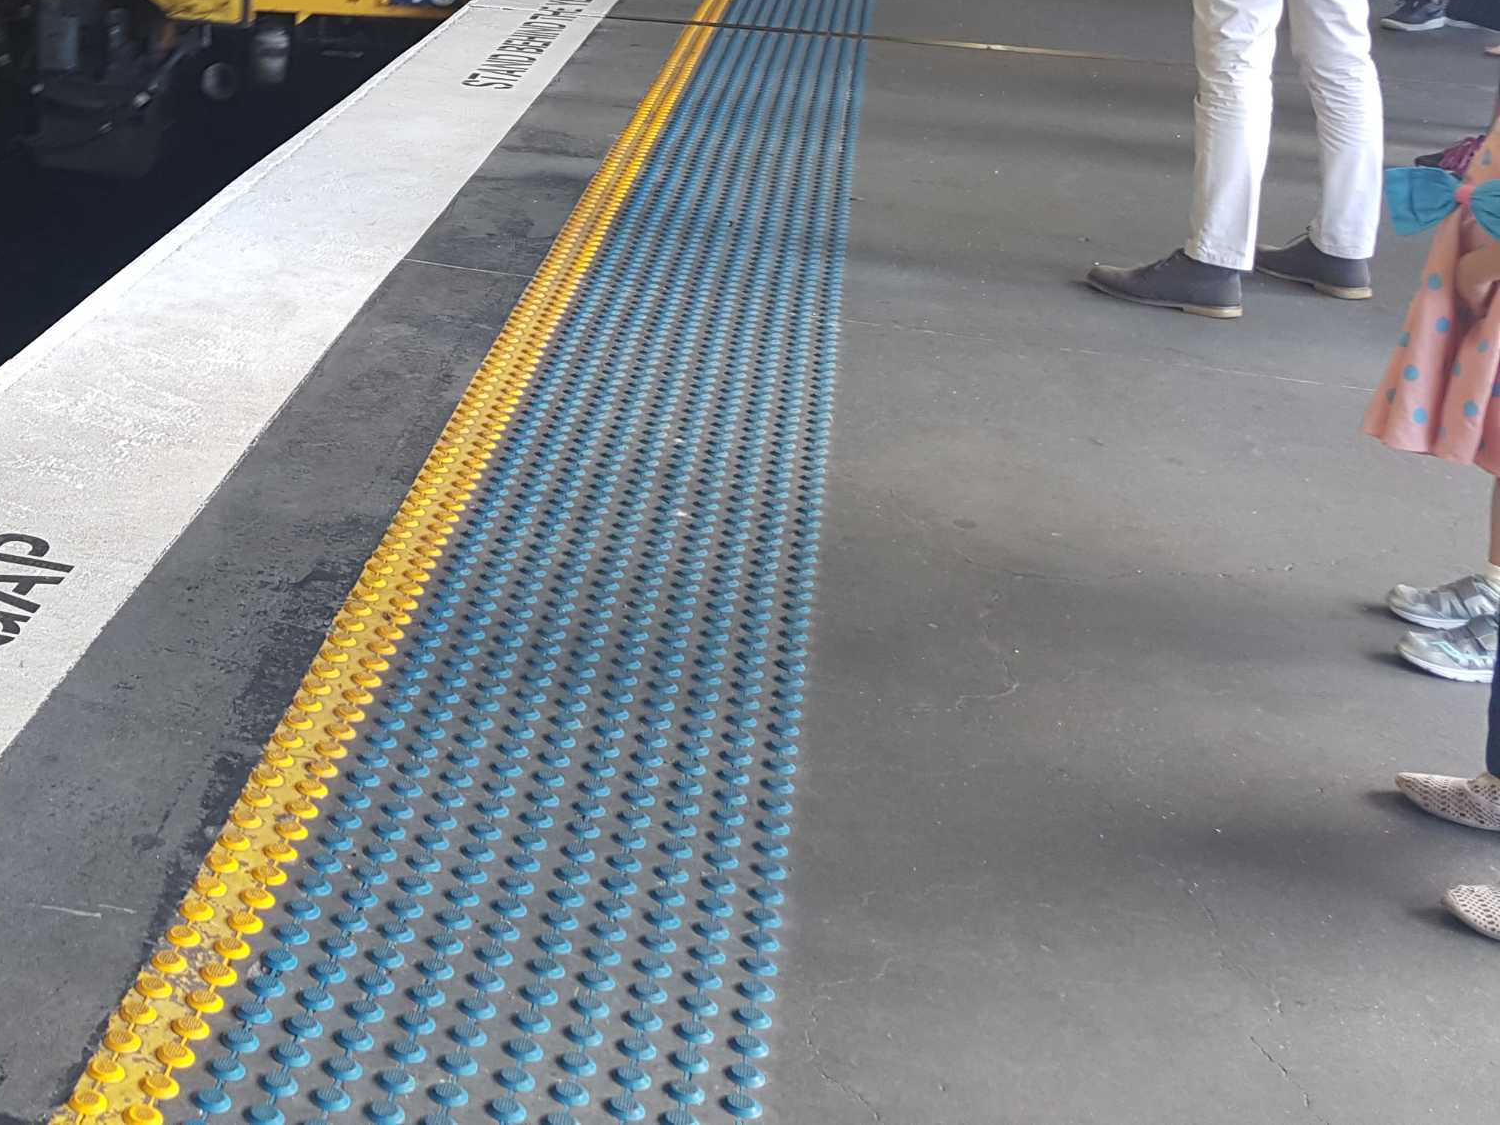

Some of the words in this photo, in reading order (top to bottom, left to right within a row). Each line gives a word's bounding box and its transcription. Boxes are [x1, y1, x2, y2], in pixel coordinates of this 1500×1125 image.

[529, 6, 584, 22] THE
[496, 21, 567, 55] BEHIND
[461, 53, 537, 90] STAND
